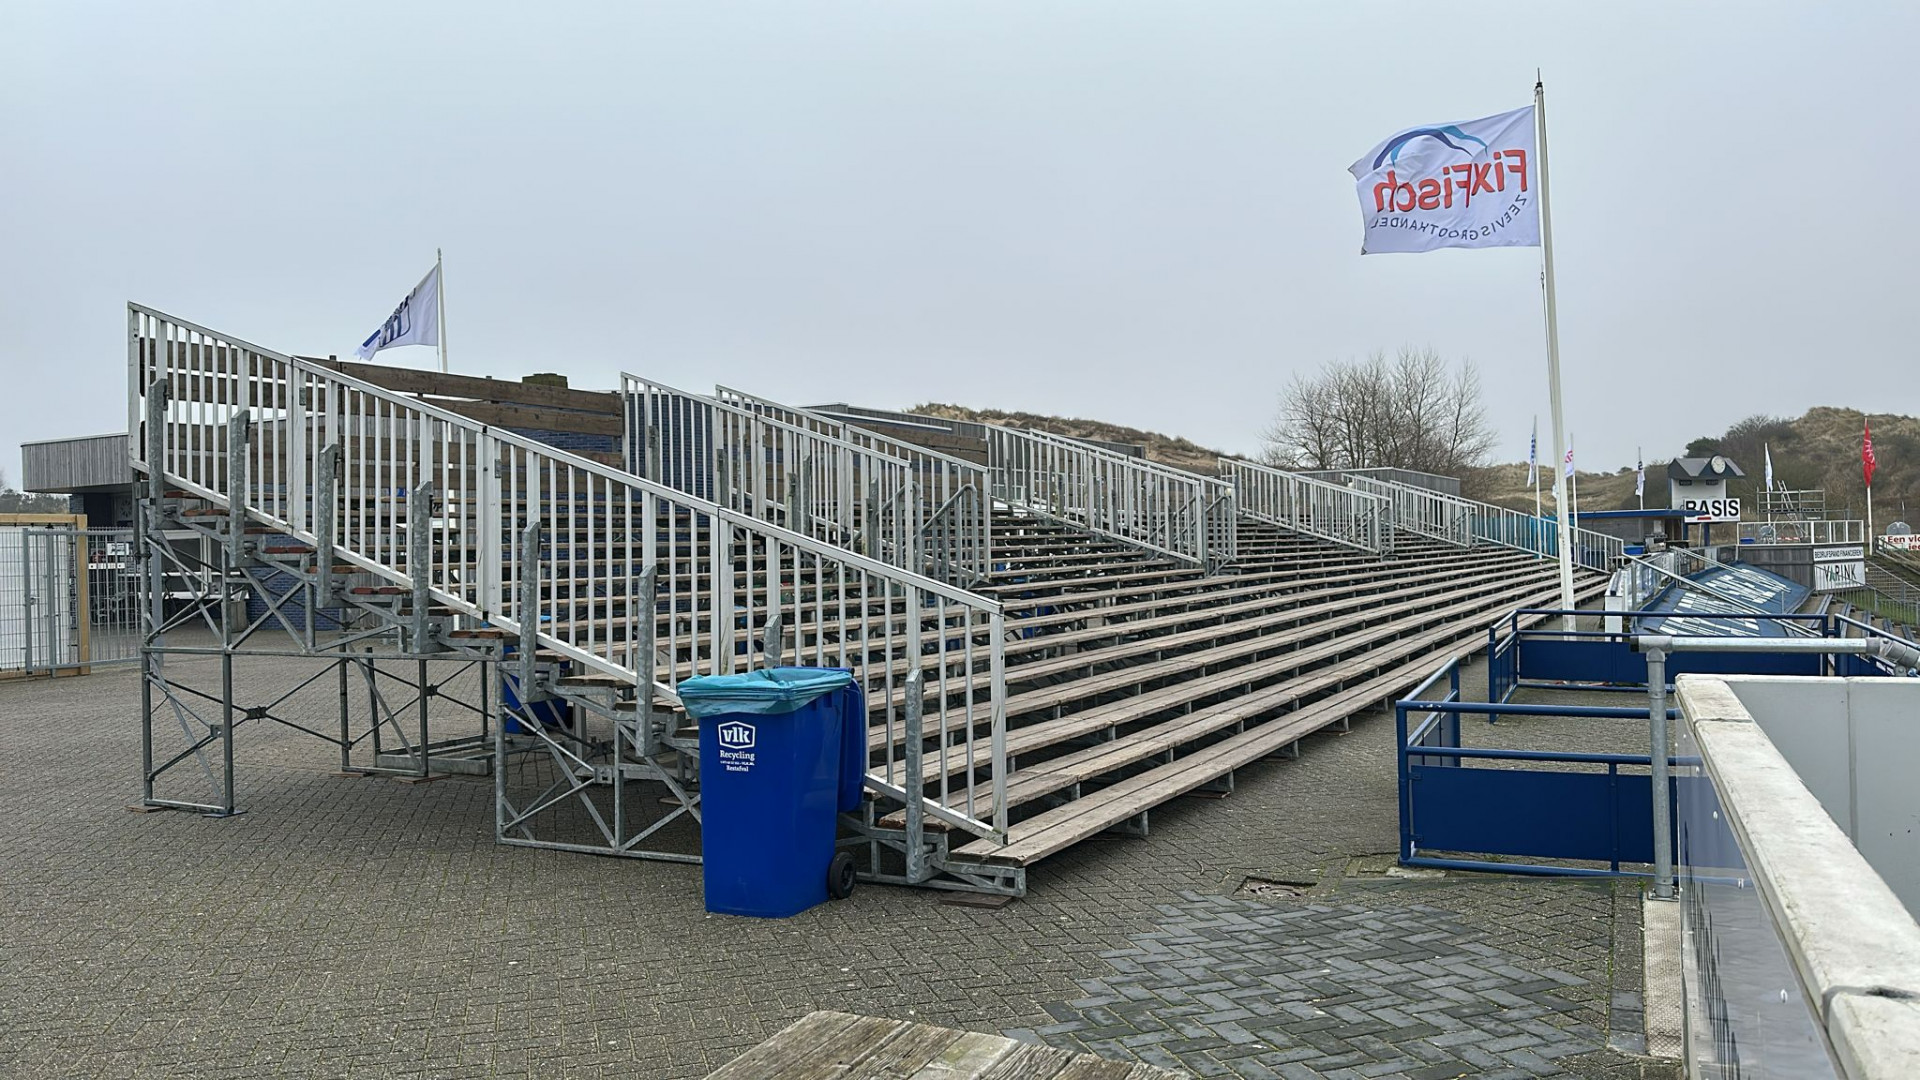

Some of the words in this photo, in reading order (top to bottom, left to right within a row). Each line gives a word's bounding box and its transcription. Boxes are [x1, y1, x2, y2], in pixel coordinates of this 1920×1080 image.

[1686, 500, 1739, 516] BASIS
[722, 726, 750, 743] vlk
[720, 750, 755, 761] Recycling
